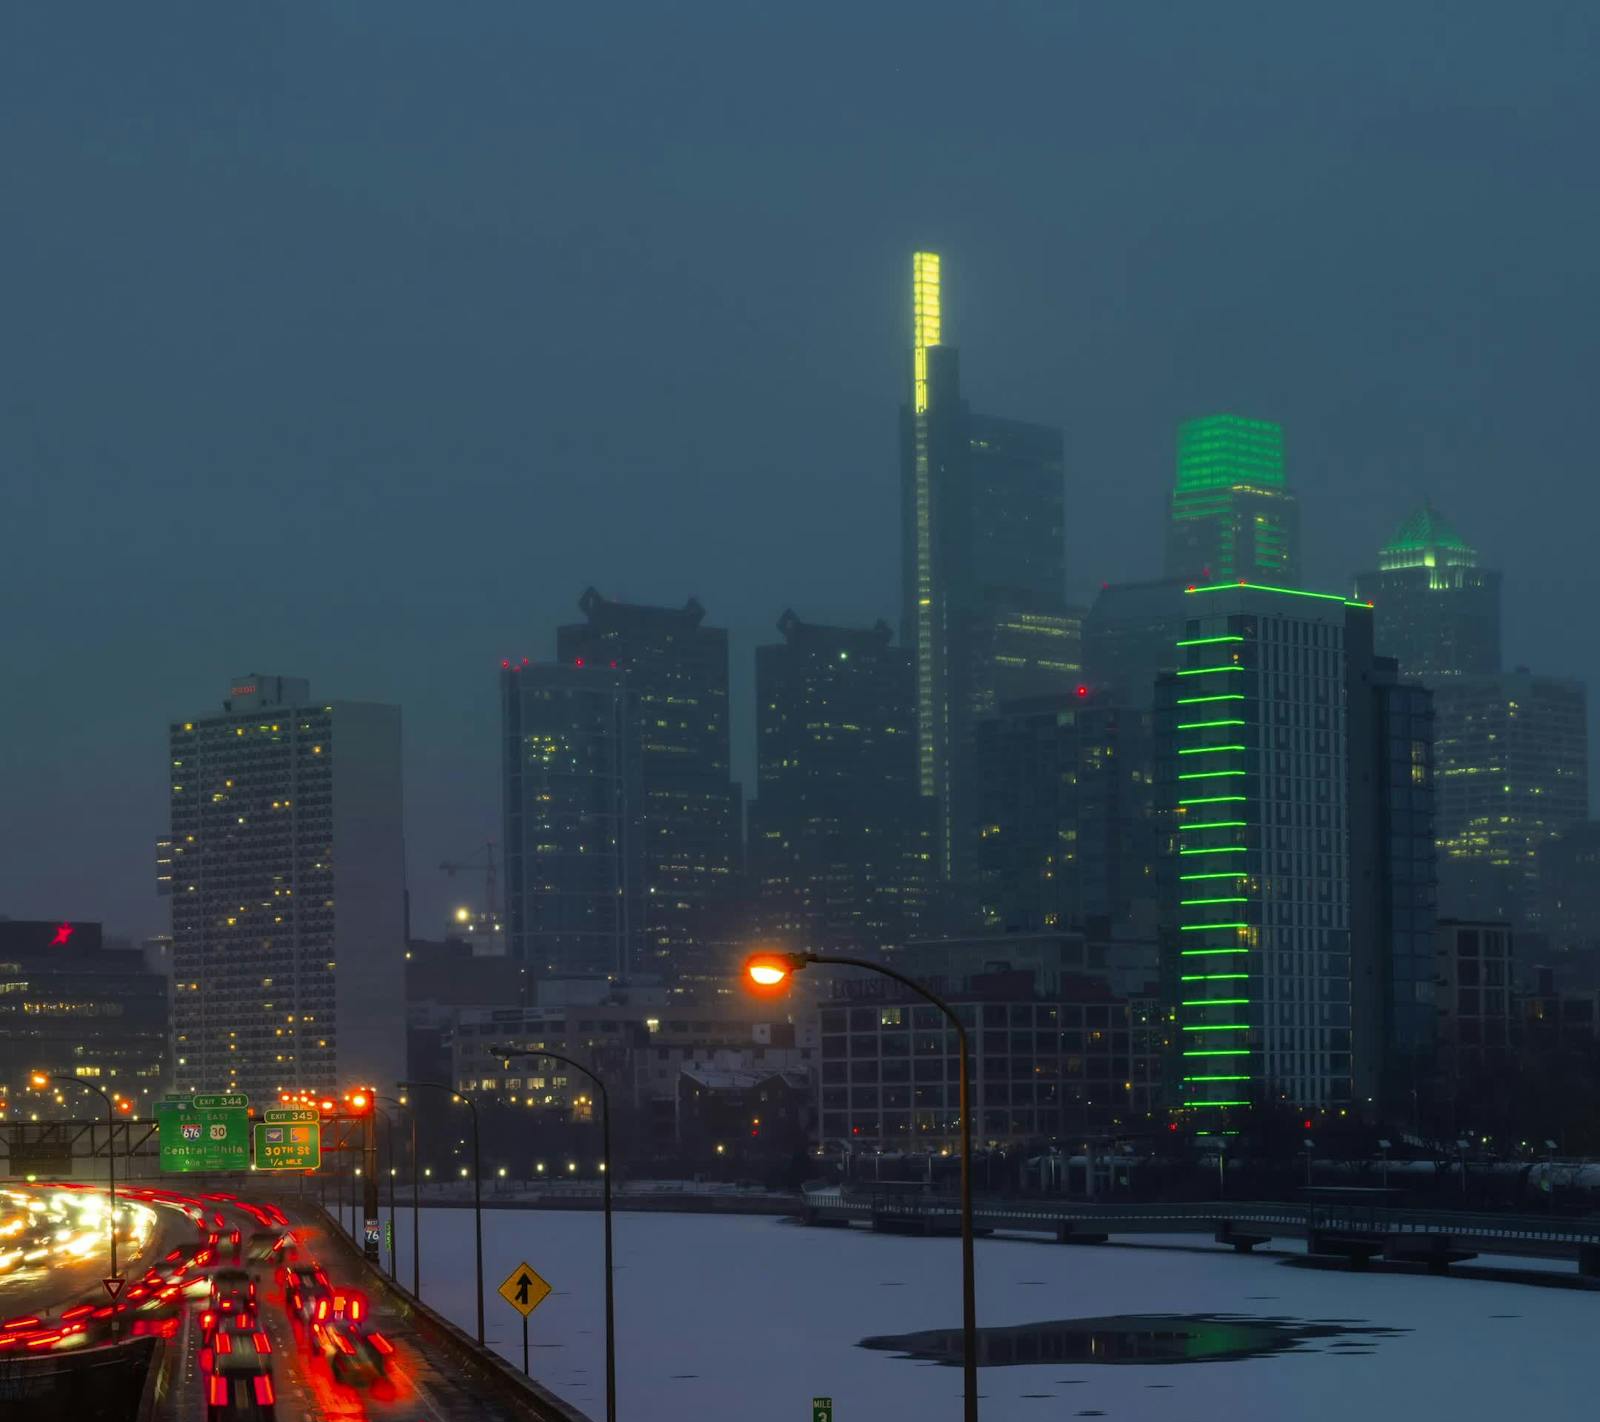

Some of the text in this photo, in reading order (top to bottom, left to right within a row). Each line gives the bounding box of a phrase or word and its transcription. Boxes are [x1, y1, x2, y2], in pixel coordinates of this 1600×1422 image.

[221, 1097, 242, 1105] 344
[207, 1113, 228, 1121] EAST
[291, 1111, 313, 1120] 345
[183, 1128, 200, 1138] 676
[211, 1127, 225, 1137] 30
[164, 1145, 207, 1155] Central
[297, 1146, 311, 1156] St
[366, 1230, 379, 1240] 76
[813, 1400, 832, 1408] MILE
